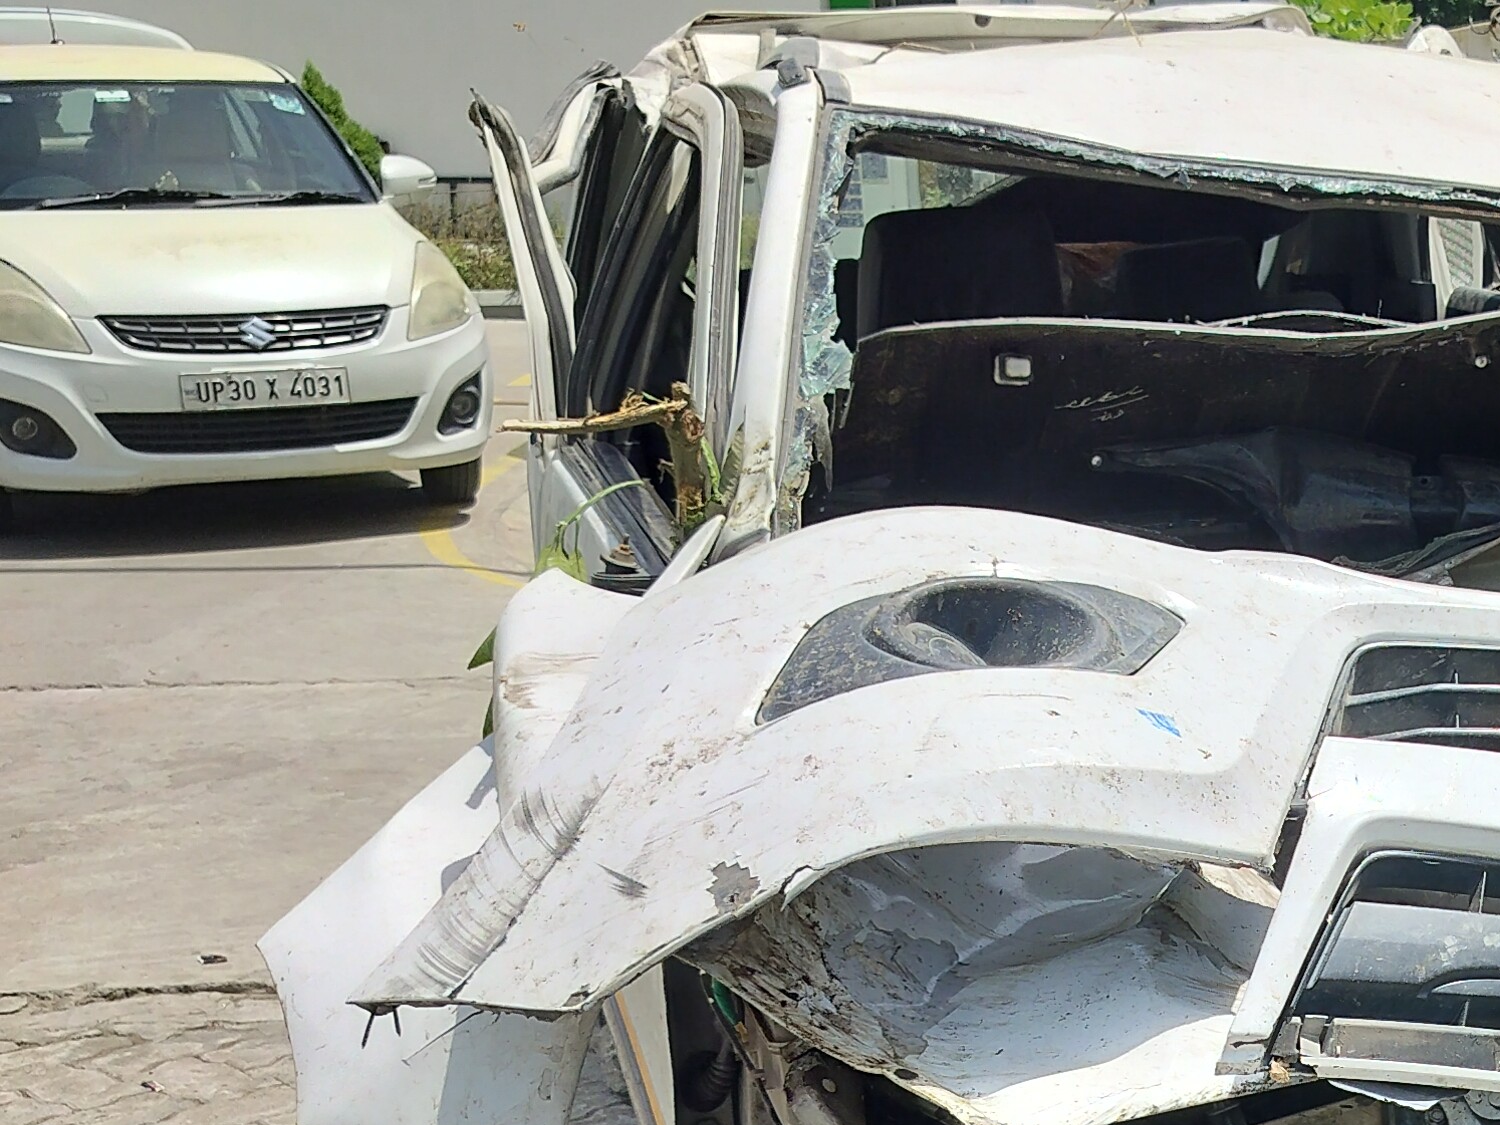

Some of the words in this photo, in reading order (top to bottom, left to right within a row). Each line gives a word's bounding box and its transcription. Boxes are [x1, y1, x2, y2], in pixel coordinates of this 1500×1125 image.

[196, 379, 257, 403] UP30
[266, 378, 280, 400] X
[290, 375, 344, 398] 4031
